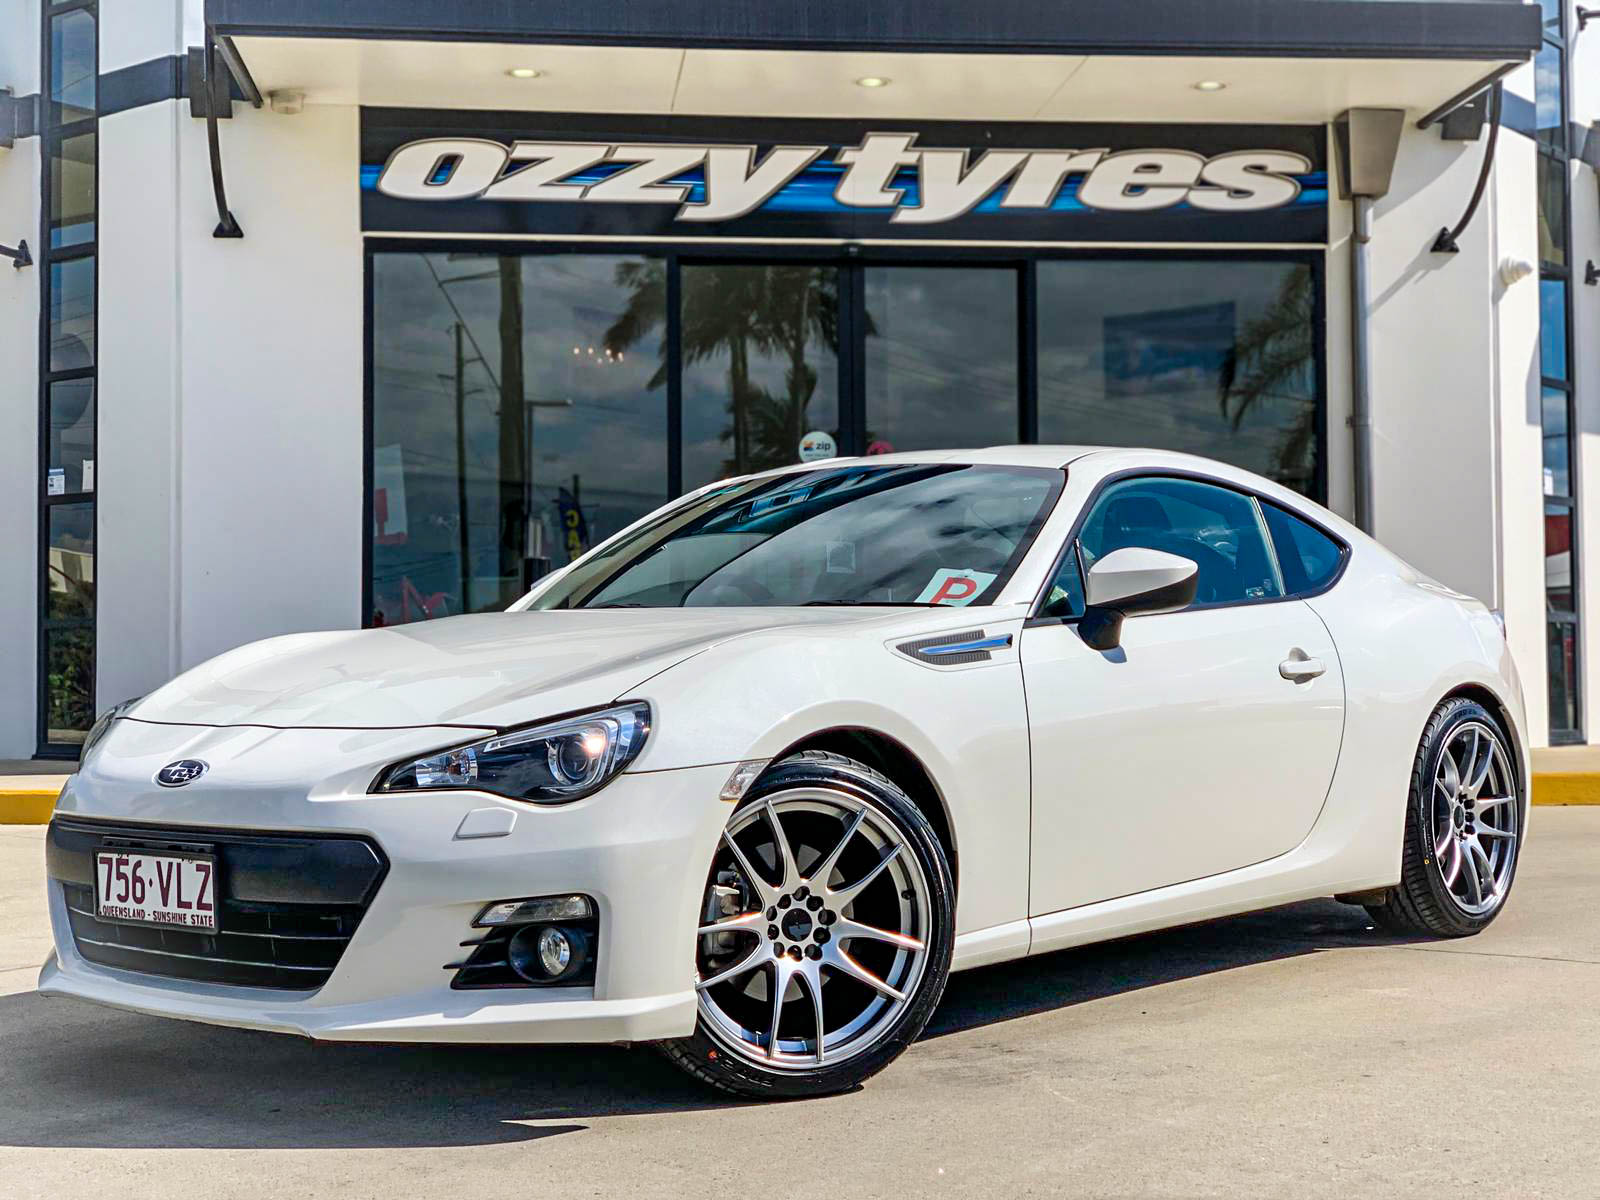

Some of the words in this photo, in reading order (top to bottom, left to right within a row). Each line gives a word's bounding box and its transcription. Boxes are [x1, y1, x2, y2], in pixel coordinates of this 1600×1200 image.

[376, 136, 828, 222] ozzy
[833, 131, 1313, 224] tyres
[815, 441, 831, 451] zip
[929, 576, 977, 604] P
[102, 905, 146, 920] QUEENSLAND
[152, 910, 187, 924] SUNSHINE
[190, 914, 213, 927] STATE
